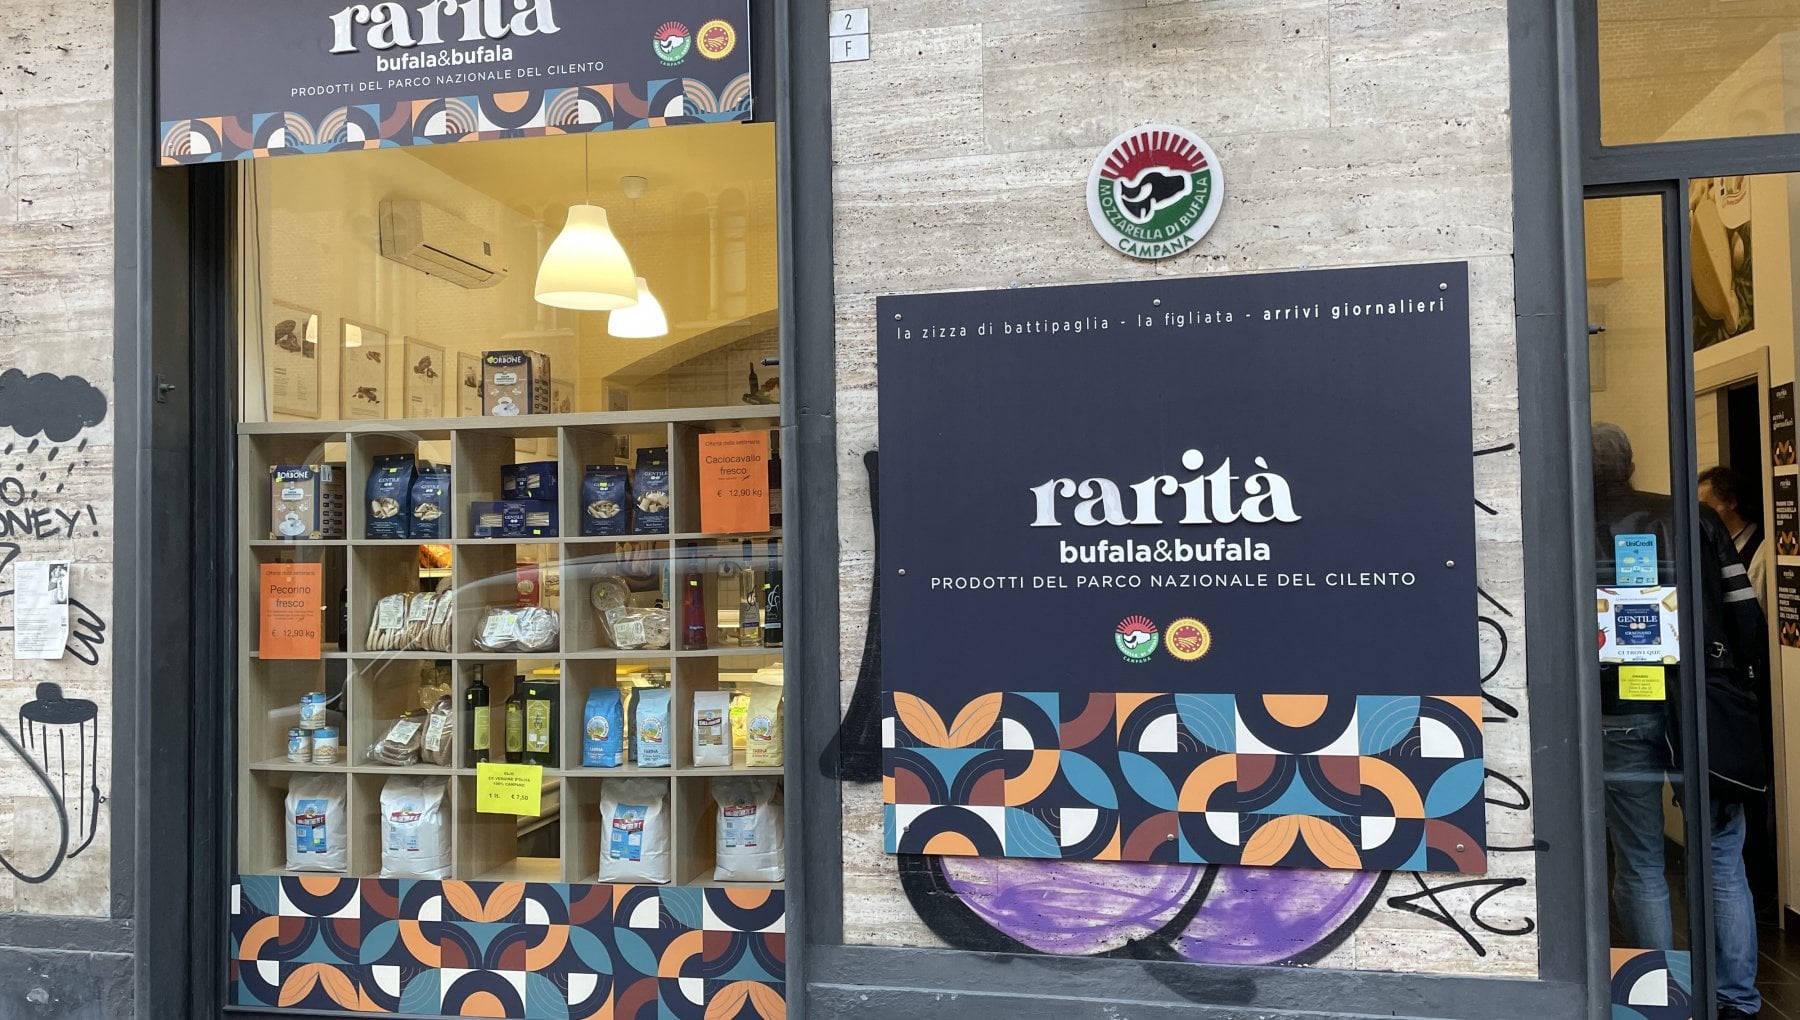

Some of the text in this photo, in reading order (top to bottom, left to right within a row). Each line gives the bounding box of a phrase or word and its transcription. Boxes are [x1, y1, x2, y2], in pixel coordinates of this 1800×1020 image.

[844, 13, 852, 30] 2
[845, 40, 852, 57] F
[376, 45, 513, 72] bufala&bufala
[291, 61, 604, 97] PRODOTTI DEL PARCO NAZIONALE DEL CILENTO
[1100, 177, 1208, 240] MOZZARELLA DI BUFALA
[1118, 234, 1194, 257] CAMPANA
[897, 327, 911, 340] la
[922, 325, 967, 339] zizza
[977, 322, 993, 336] di
[1004, 316, 1109, 335] battipaglia
[1137, 314, 1153, 328] la
[1164, 310, 1233, 328] figliata
[1263, 304, 1320, 321] arrivi
[1331, 297, 1444, 319] giornalieri
[705, 453, 761, 464] Caciocavallo
[720, 466, 747, 475] fresco
[729, 488, 751, 498] 12,90
[752, 488, 763, 498] kg
[1029, 448, 1303, 527] rarità
[1059, 537, 1271, 564] bufala&bufala
[270, 584, 311, 594] Pecorino
[931, 572, 1416, 590] PRODOTTI DEL PARCO NAZIONALE DEL CILENTO
[276, 598, 305, 608] fresco
[1617, 615, 1658, 623] GENTILE
[283, 629, 304, 638] 12,90
[305, 629, 315, 639] kg
